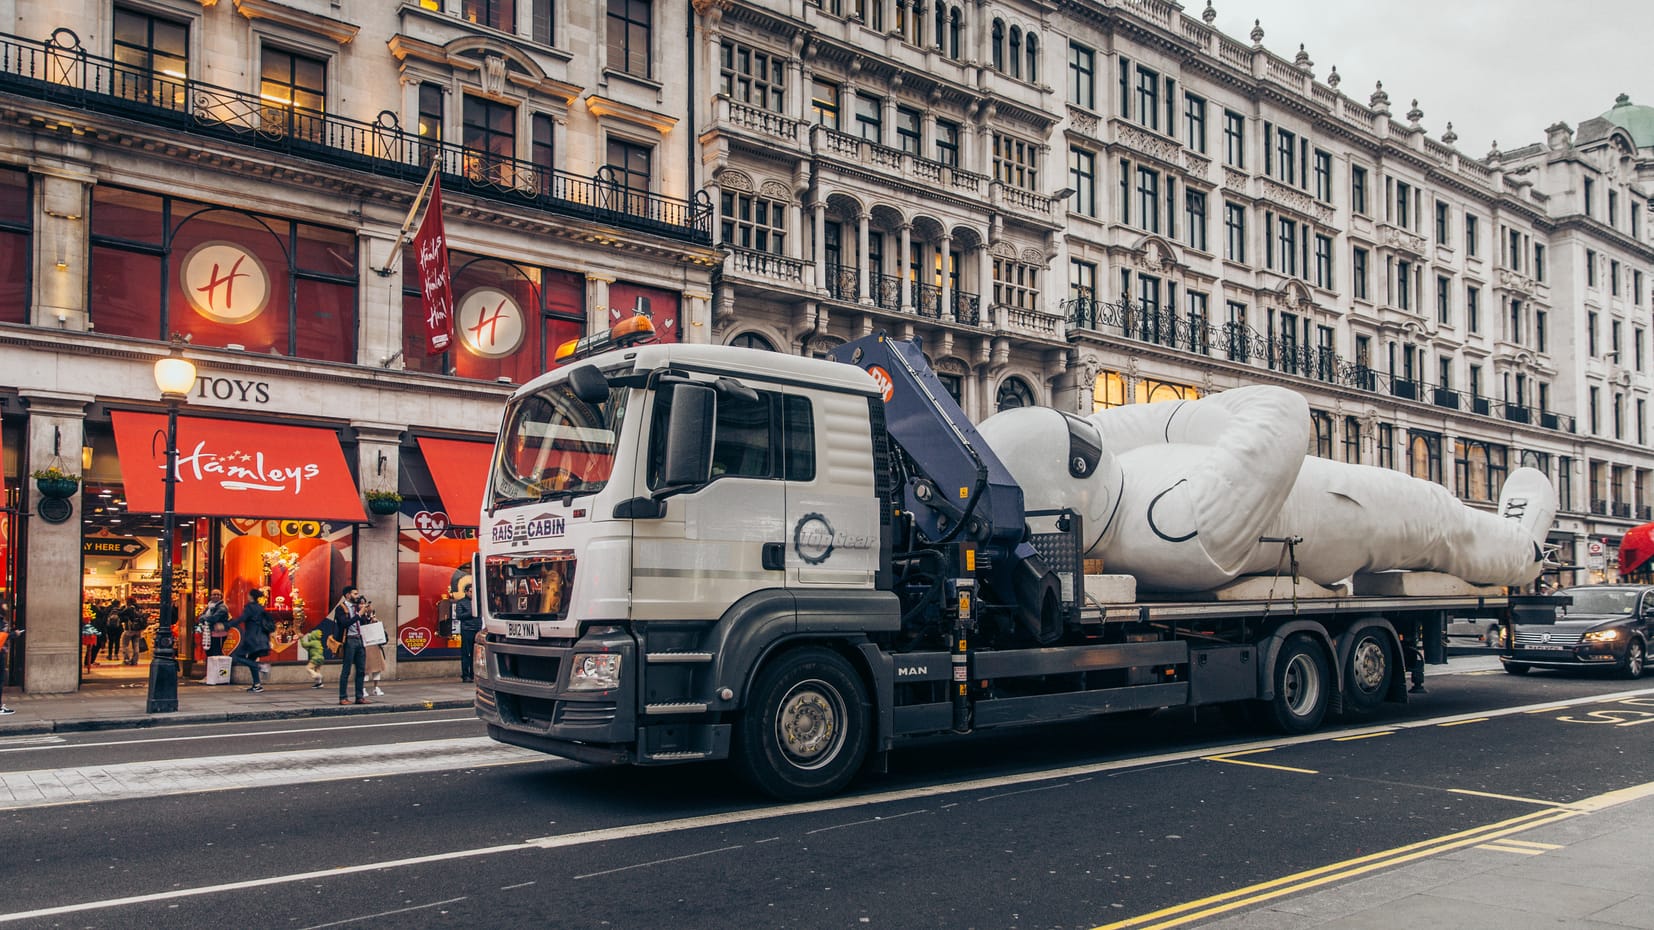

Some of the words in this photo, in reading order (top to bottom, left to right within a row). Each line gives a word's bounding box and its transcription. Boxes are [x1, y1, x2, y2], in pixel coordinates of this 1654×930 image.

[196, 254, 251, 310] H
[467, 299, 511, 347] H
[196, 375, 270, 404] TOYS
[159, 440, 320, 495] Hamleys
[417, 513, 445, 537] ty
[492, 525, 513, 542] RAIS
[527, 518, 565, 537] CABIN
[95, 543, 121, 552] HERE
[505, 578, 543, 596] MAN
[522, 623, 535, 637] YNA
[898, 666, 928, 676] MAN
